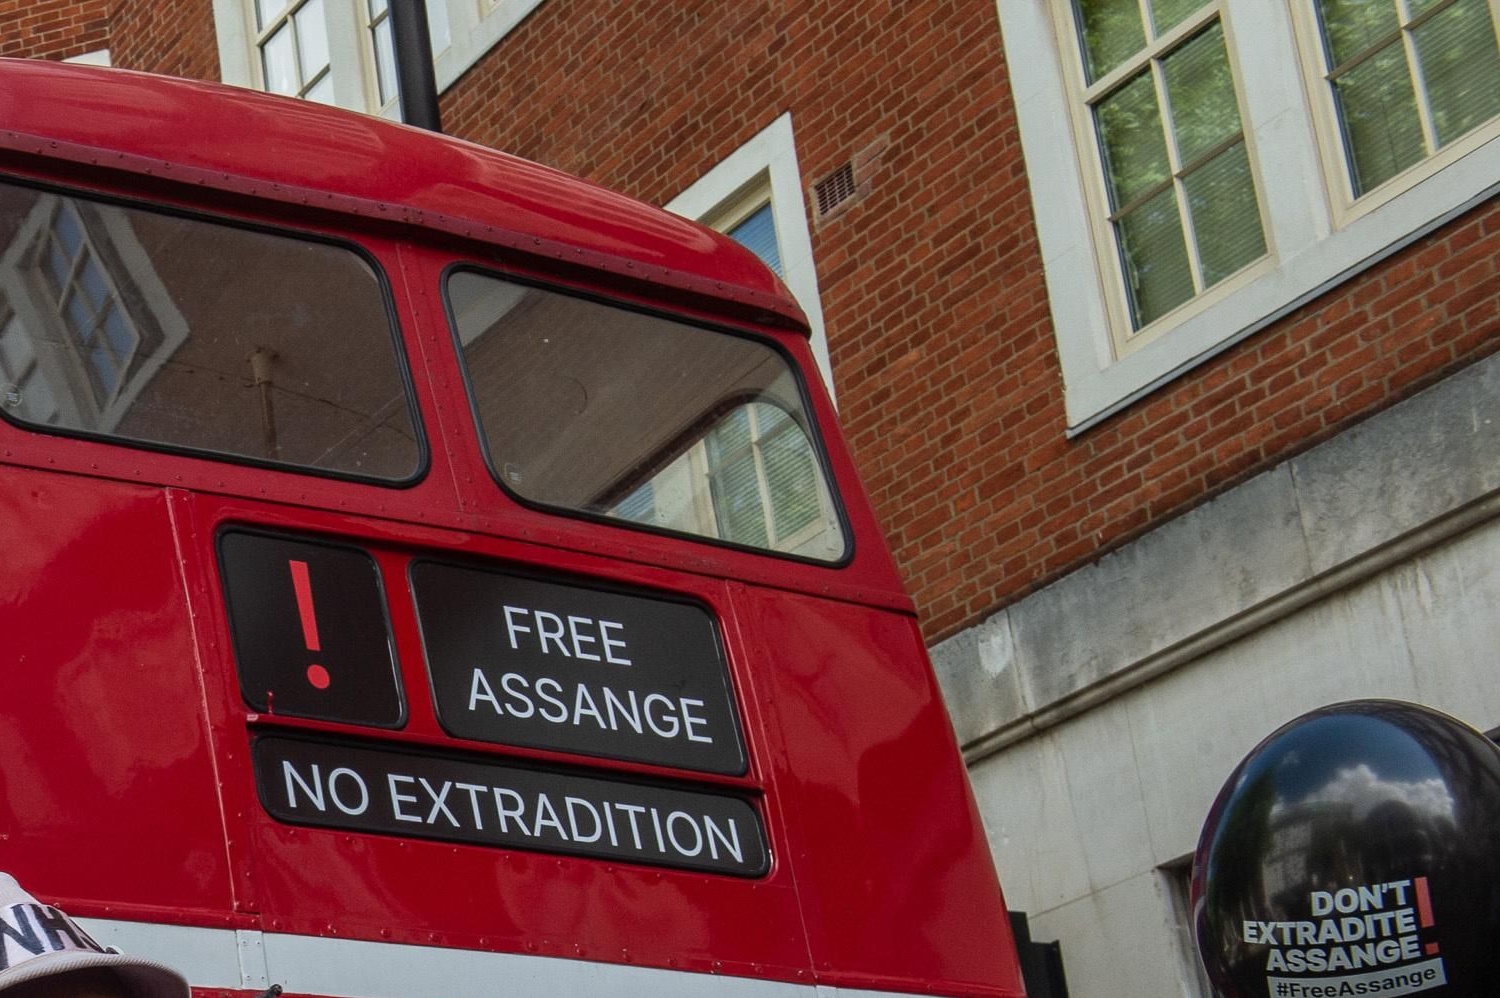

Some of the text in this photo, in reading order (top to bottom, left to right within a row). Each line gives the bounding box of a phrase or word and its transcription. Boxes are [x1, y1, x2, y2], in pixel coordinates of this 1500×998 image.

[503, 605, 632, 666] FREE
[468, 668, 713, 744] ASSANGE
[282, 760, 744, 863] NO EXTRADITION
[1310, 880, 1411, 917] DON'T
[1243, 907, 1417, 945] EXTRADITE
[1276, 967, 1436, 998] #FreeAssange
